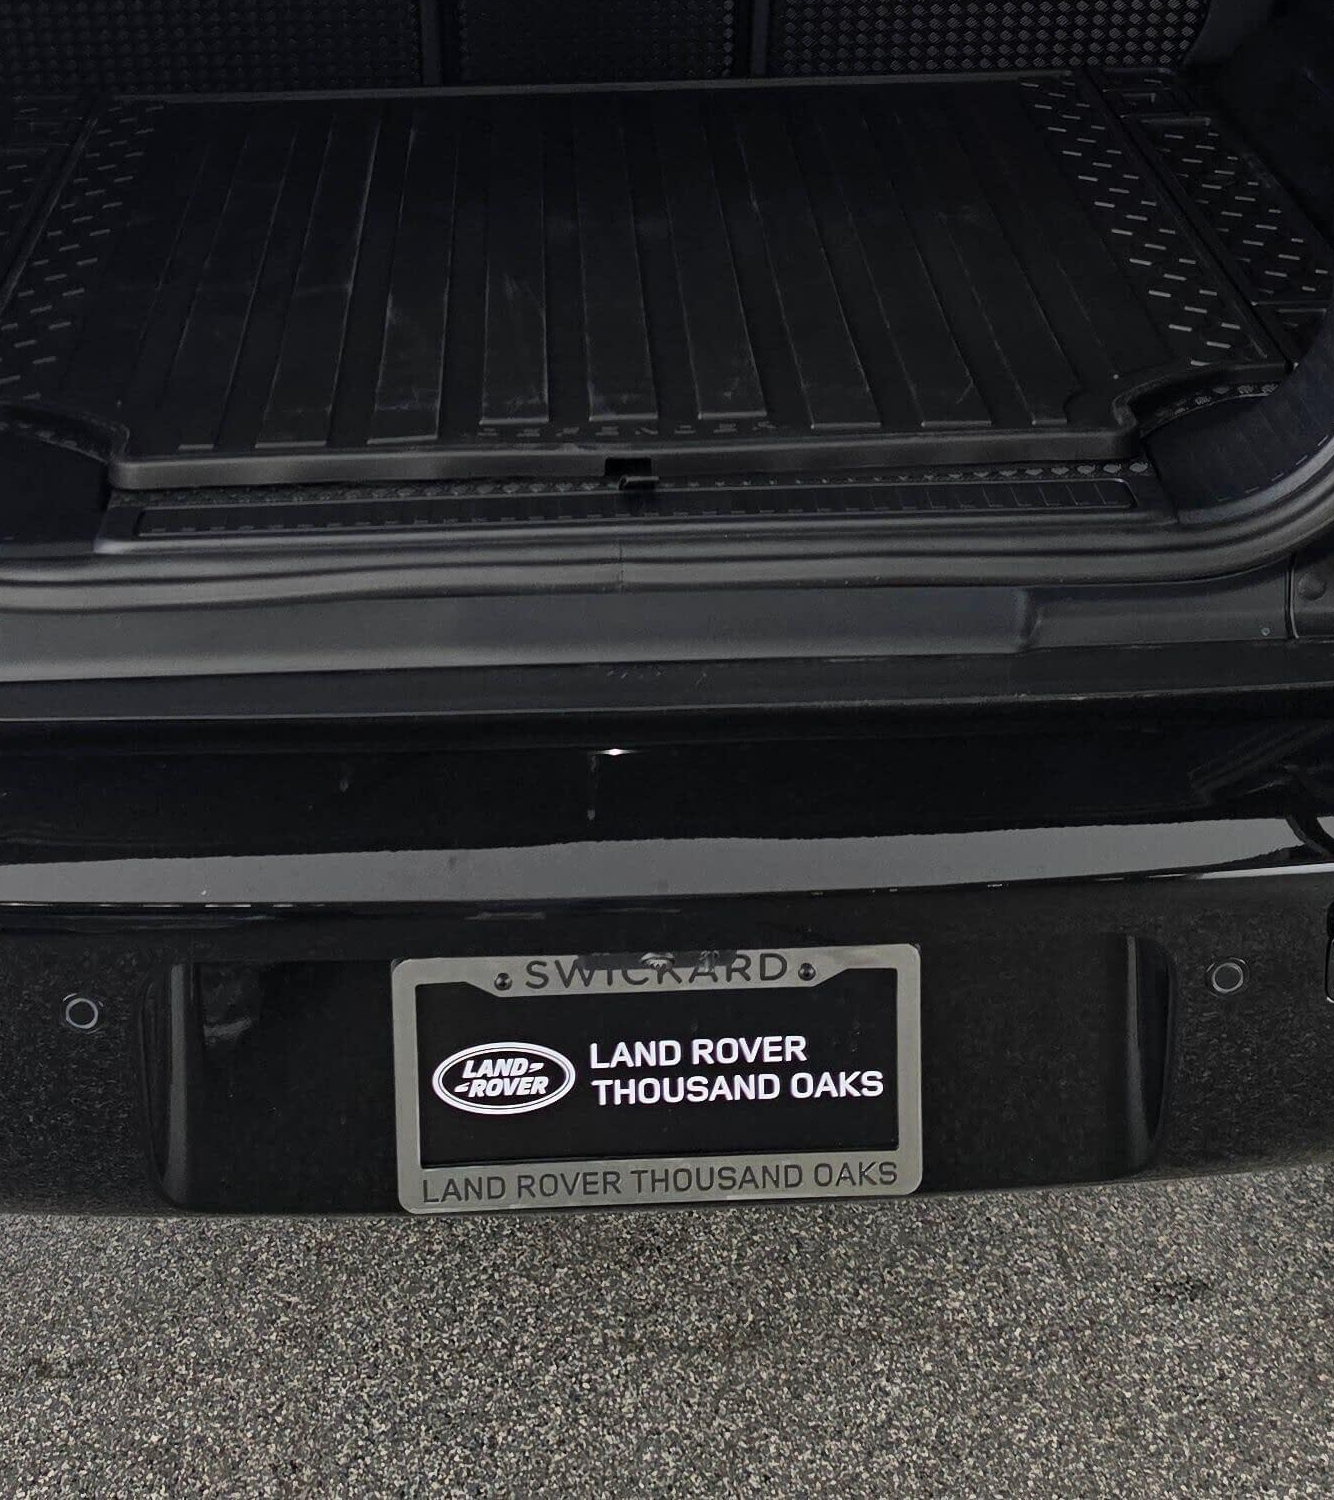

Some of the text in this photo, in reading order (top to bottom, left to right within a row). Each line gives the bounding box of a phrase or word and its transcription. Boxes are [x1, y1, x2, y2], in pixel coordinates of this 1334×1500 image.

[524, 952, 788, 989] SWICKARD
[461, 1056, 529, 1079] LAND
[589, 1035, 807, 1069] LAND ROVER
[467, 1075, 550, 1098] ROVER
[590, 1070, 884, 1106] THOUSAND OAKS
[422, 1160, 898, 1204] LAND ROVER THOUSAND OAKS
